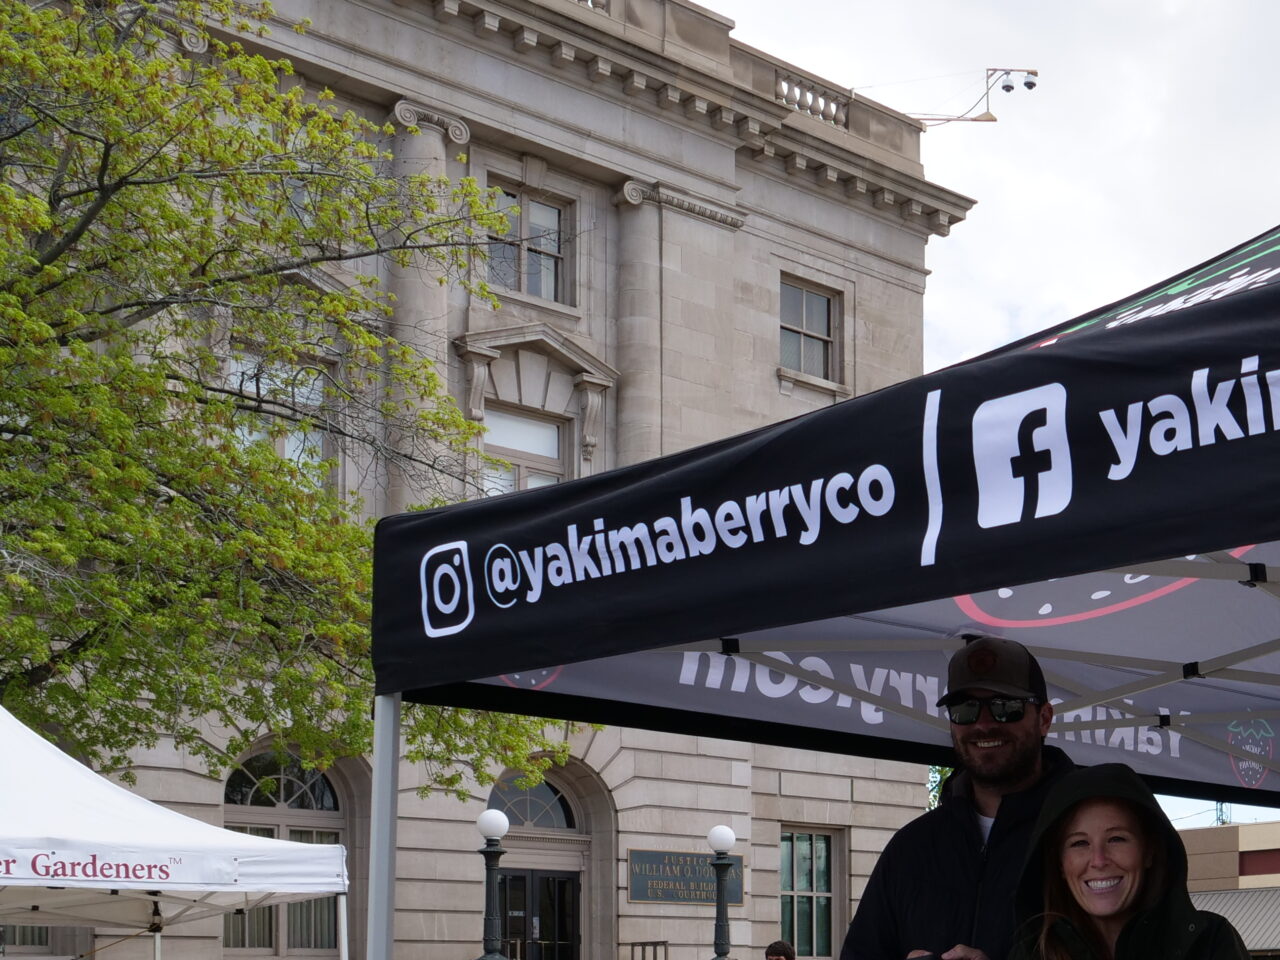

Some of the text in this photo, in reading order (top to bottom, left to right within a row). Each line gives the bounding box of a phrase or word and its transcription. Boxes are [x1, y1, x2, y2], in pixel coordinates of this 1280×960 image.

[484, 464, 895, 609] @yakimaberryco
[632, 863, 680, 876] WILLIAM
[696, 866, 742, 880] DOUAS
[648, 880, 686, 889] FEDERAL
